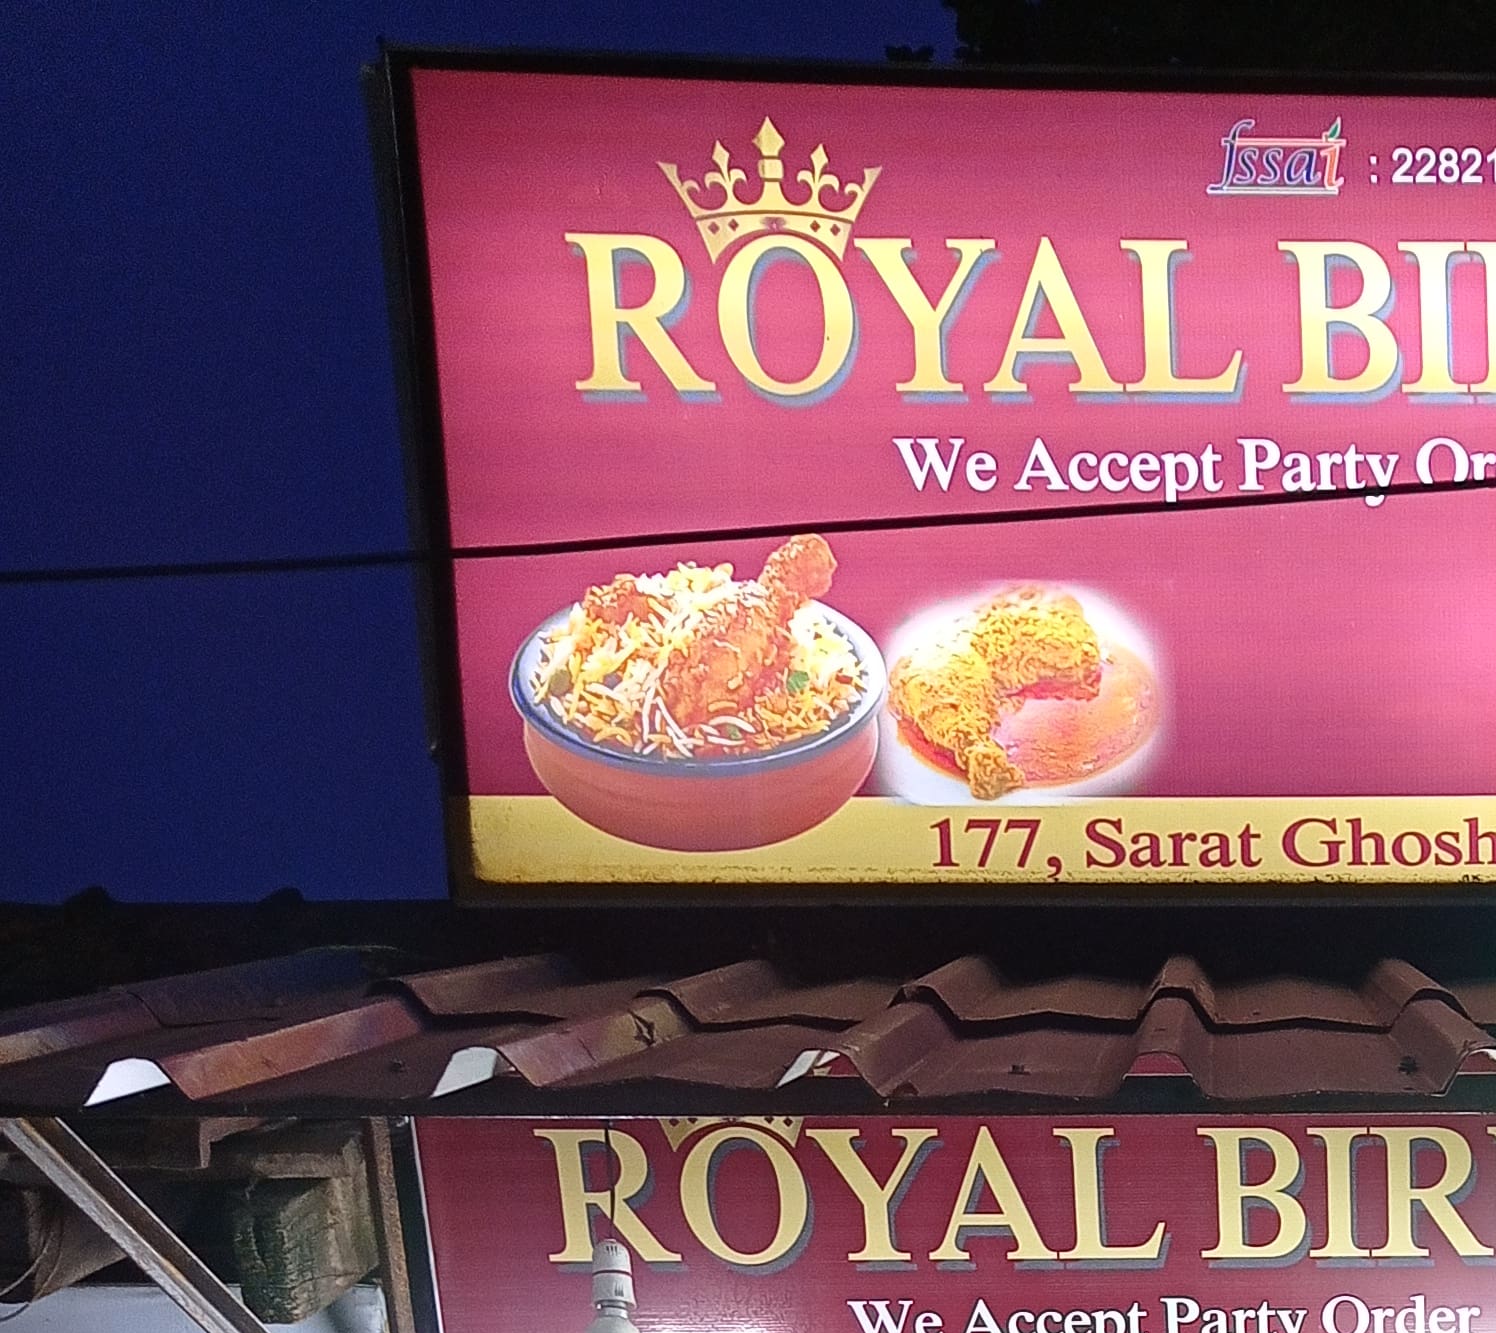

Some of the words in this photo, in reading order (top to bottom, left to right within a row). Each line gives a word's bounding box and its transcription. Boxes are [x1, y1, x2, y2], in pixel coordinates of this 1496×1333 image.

[564, 229, 1247, 403] ROYAL
[893, 436, 997, 491] We
[1013, 437, 1223, 504] Accept
[1236, 437, 1399, 507] Party
[929, 816, 1067, 880] 177,
[1083, 815, 1263, 871] Sarat
[533, 1122, 1168, 1270] ROYAL
